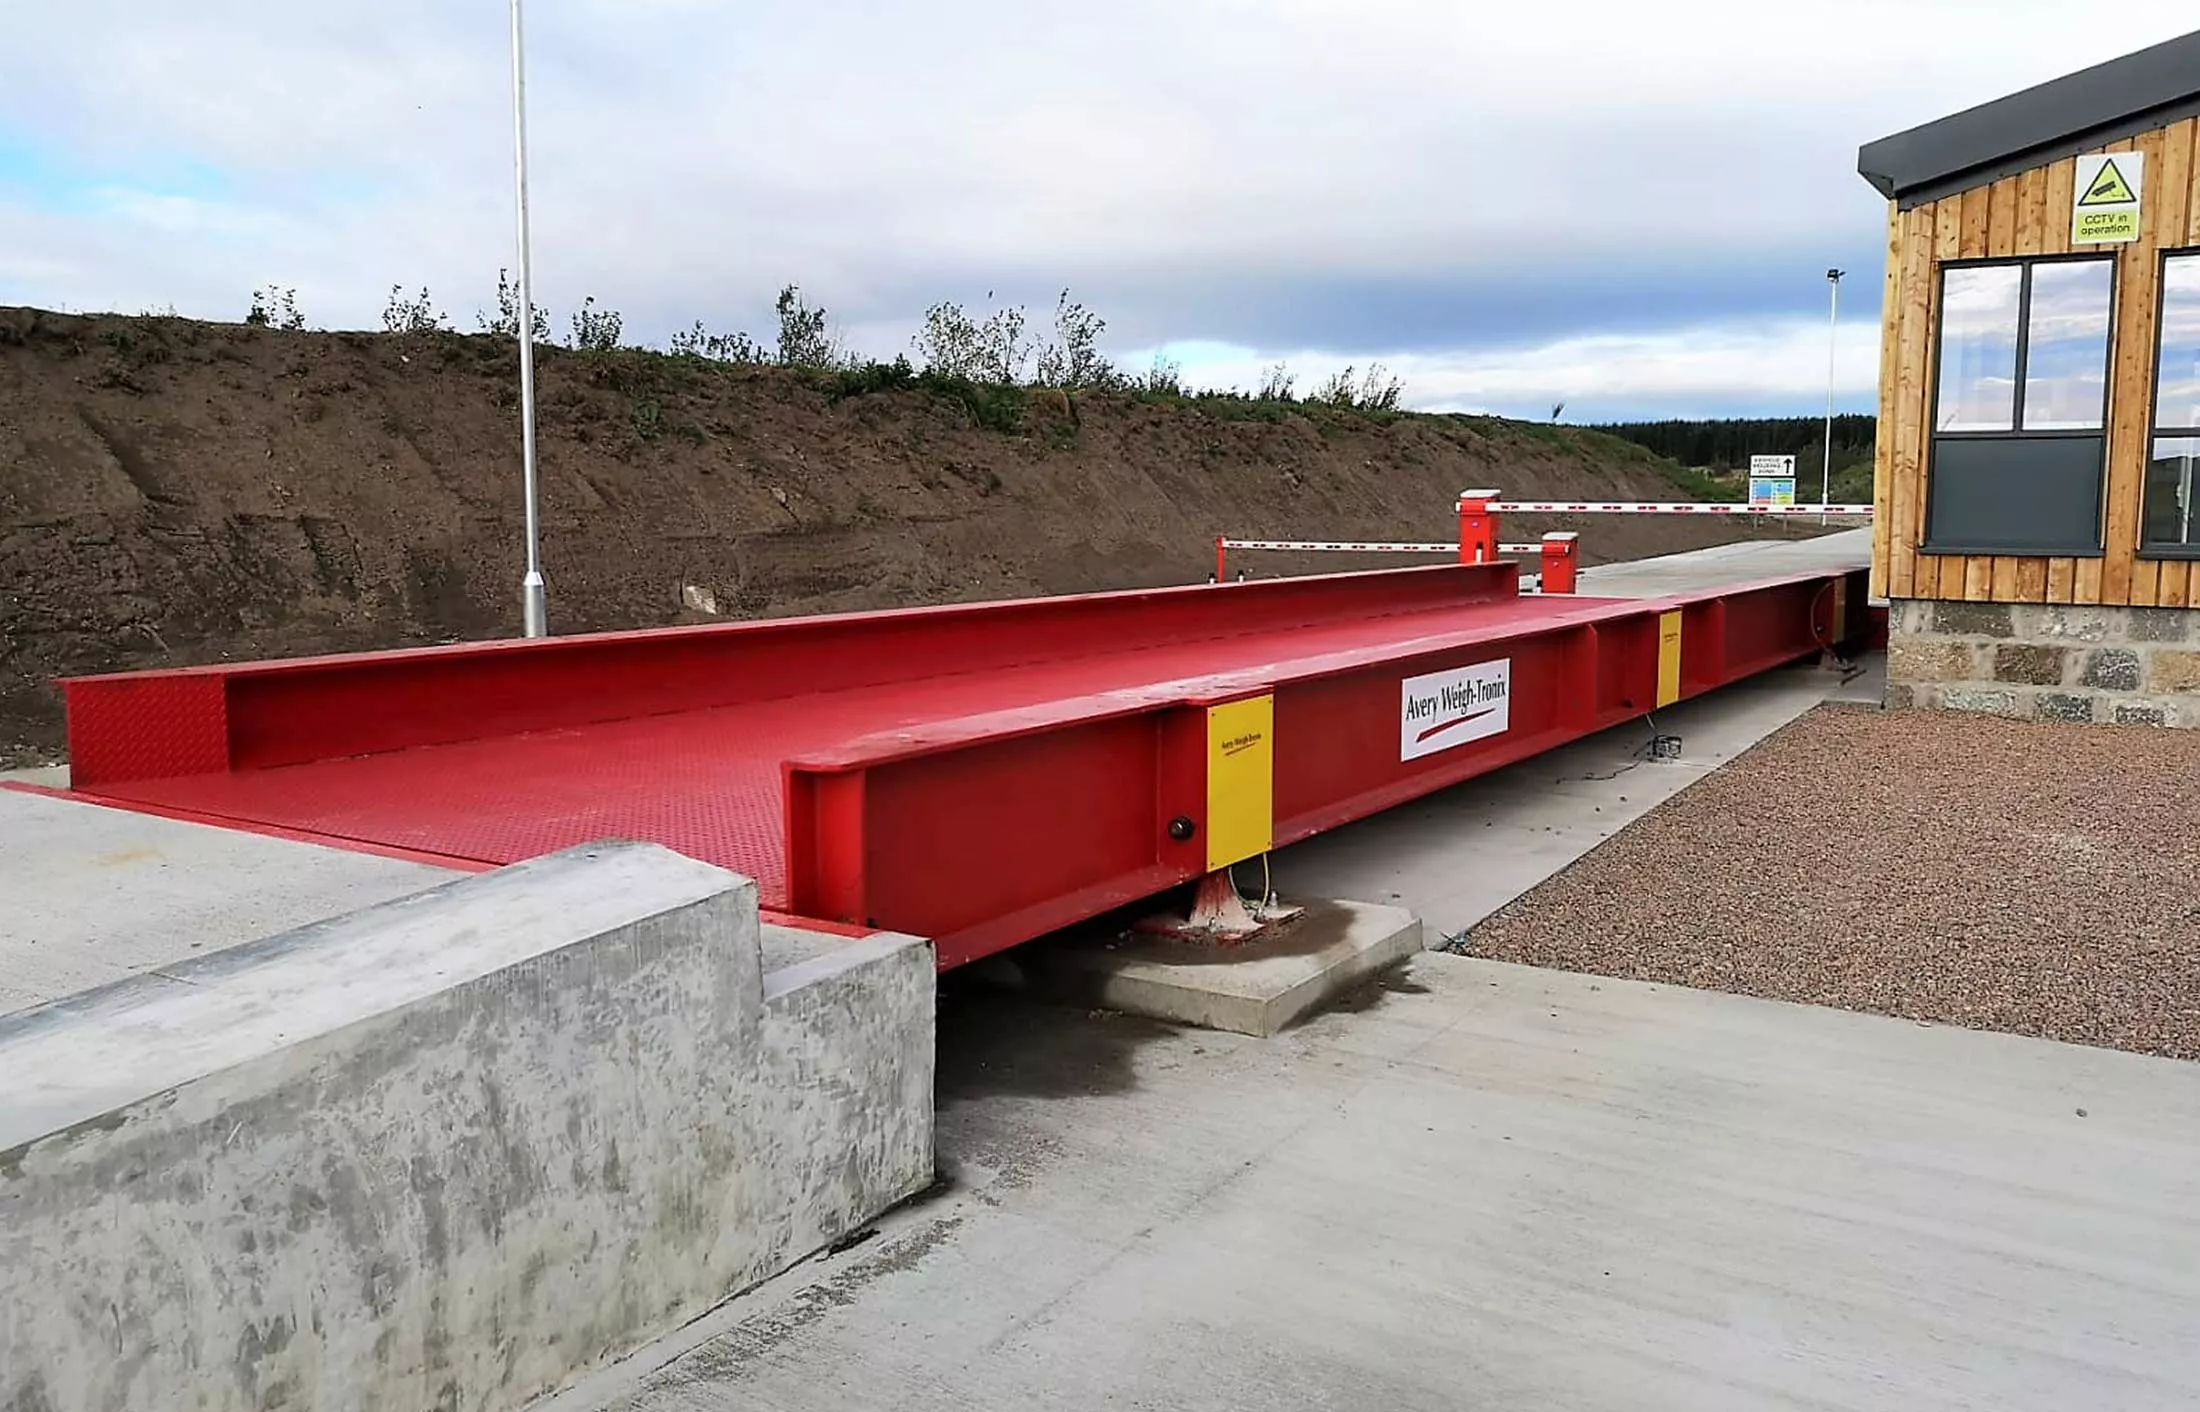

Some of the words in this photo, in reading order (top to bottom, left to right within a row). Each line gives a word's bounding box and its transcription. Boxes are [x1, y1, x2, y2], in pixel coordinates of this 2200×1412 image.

[2085, 214, 2115, 224] CCTV
[2118, 214, 2127, 222] in
[2081, 225, 2130, 235] operation
[1406, 695, 1438, 722] Avery
[1441, 673, 1506, 715] Weigh-Tronix
